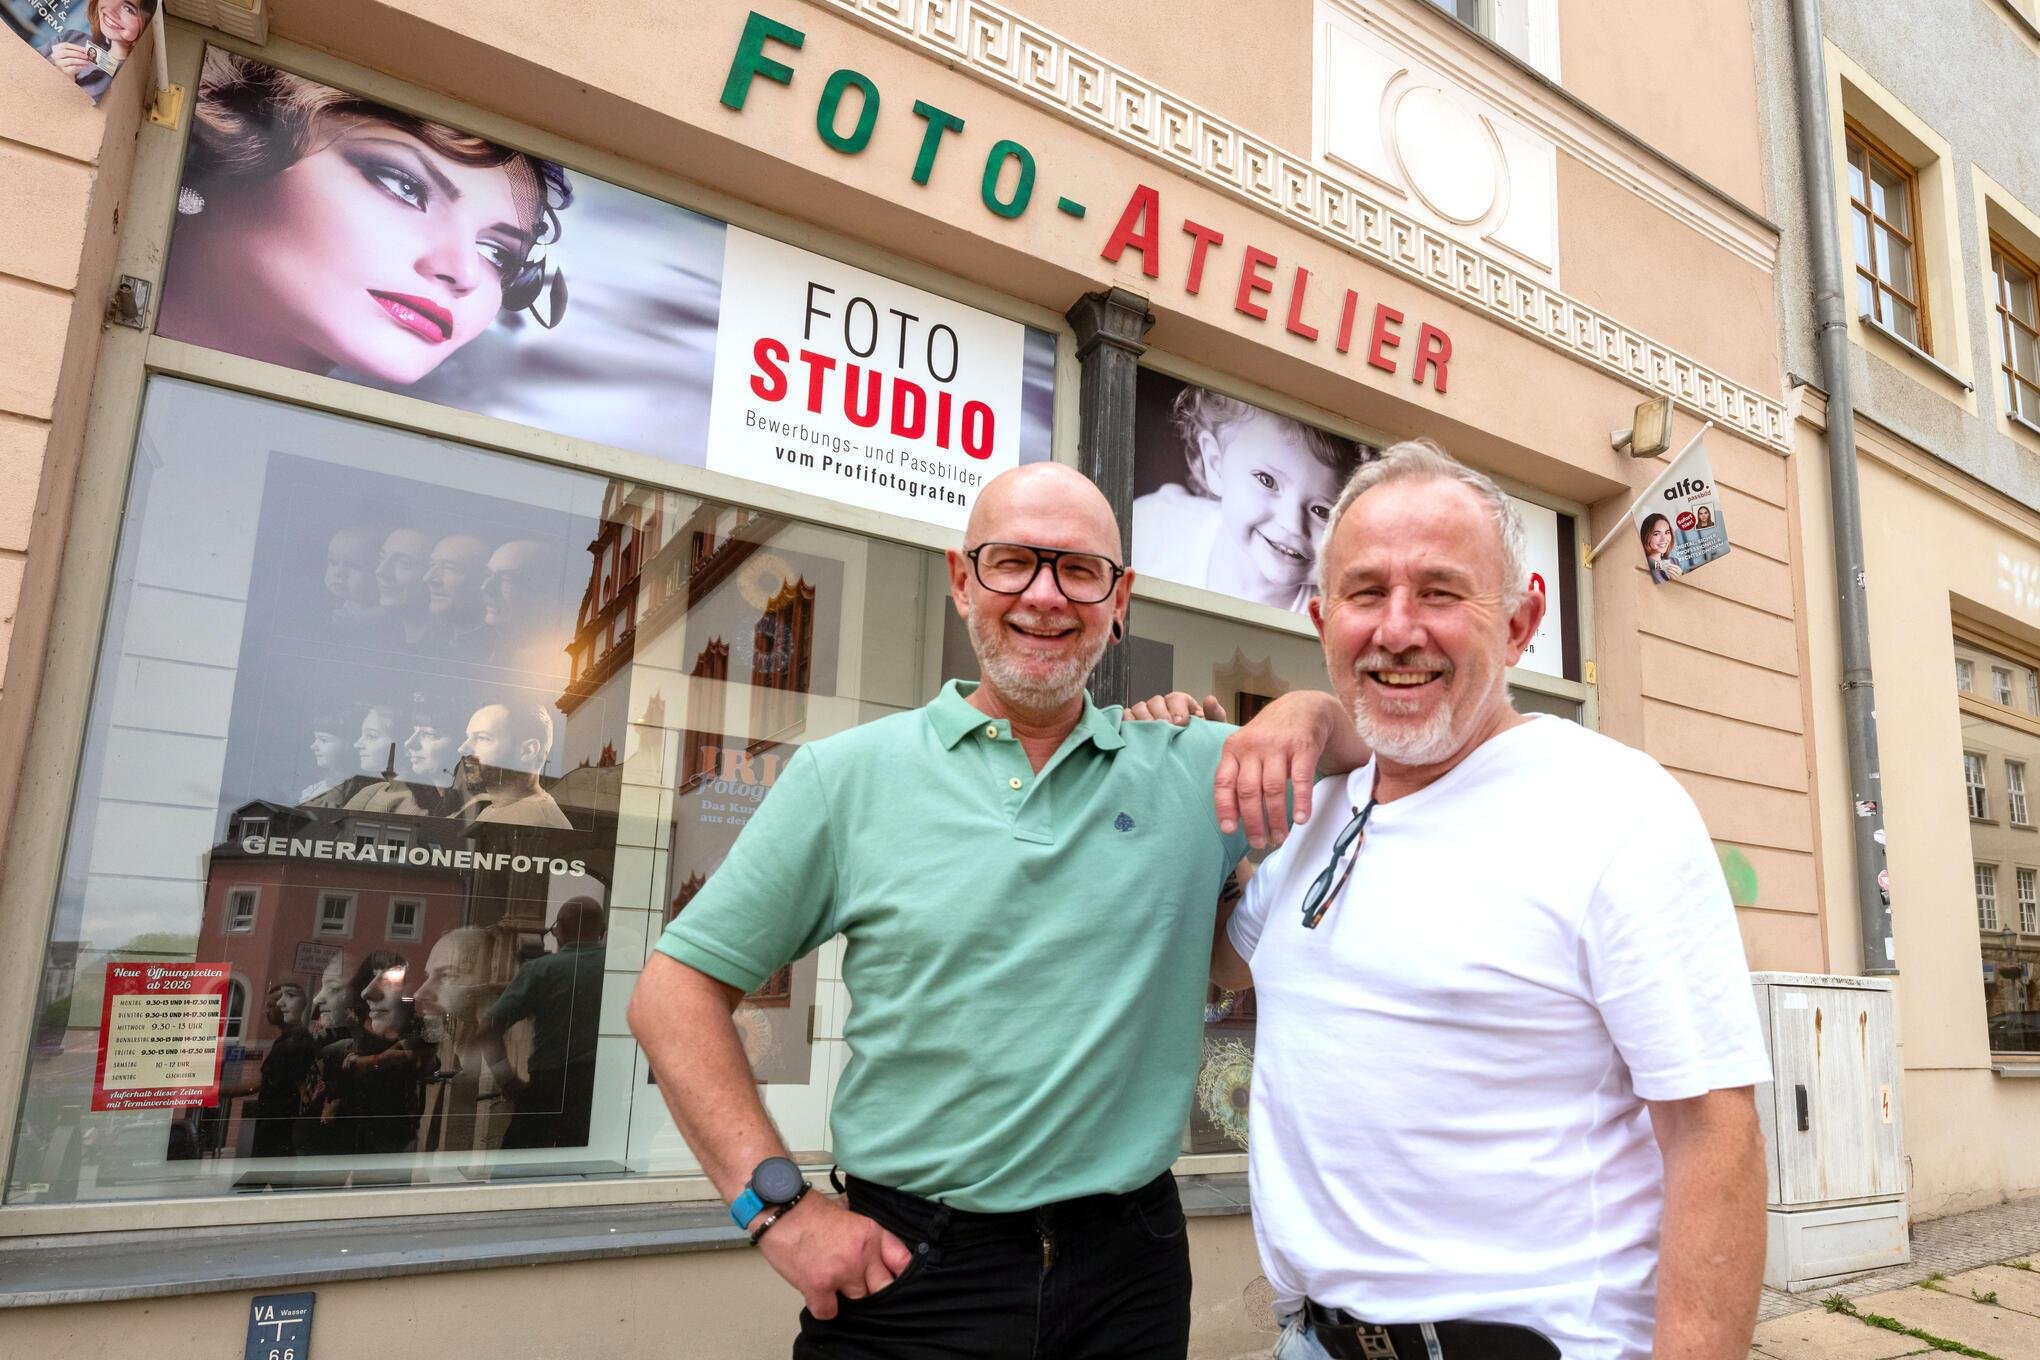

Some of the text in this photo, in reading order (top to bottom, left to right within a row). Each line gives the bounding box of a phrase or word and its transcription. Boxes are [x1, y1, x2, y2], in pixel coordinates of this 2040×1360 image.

[58, 11, 67, 21] &
[720, 10, 1452, 394] FOTO-ATELIER
[804, 281, 958, 383] FOTO
[750, 337, 995, 460] STUDIO
[746, 409, 982, 487] Bewerbungs- und Passbilder
[775, 446, 966, 506] vom Profifotografen
[1687, 490, 1711, 502] passbild
[700, 746, 786, 787] IRI
[702, 800, 725, 812] Das
[700, 814, 722, 824] aus
[242, 835, 586, 877] GENERATIONENFOTOS
[113, 965, 222, 979] Neue Öffnungszeiten
[146, 980, 191, 990] ab 2026
[110, 1088, 203, 1099] Außerhalb dieser Zeiten
[122, 1098, 203, 1108] Terminvereinbarung
[254, 1305, 274, 1321] VA
